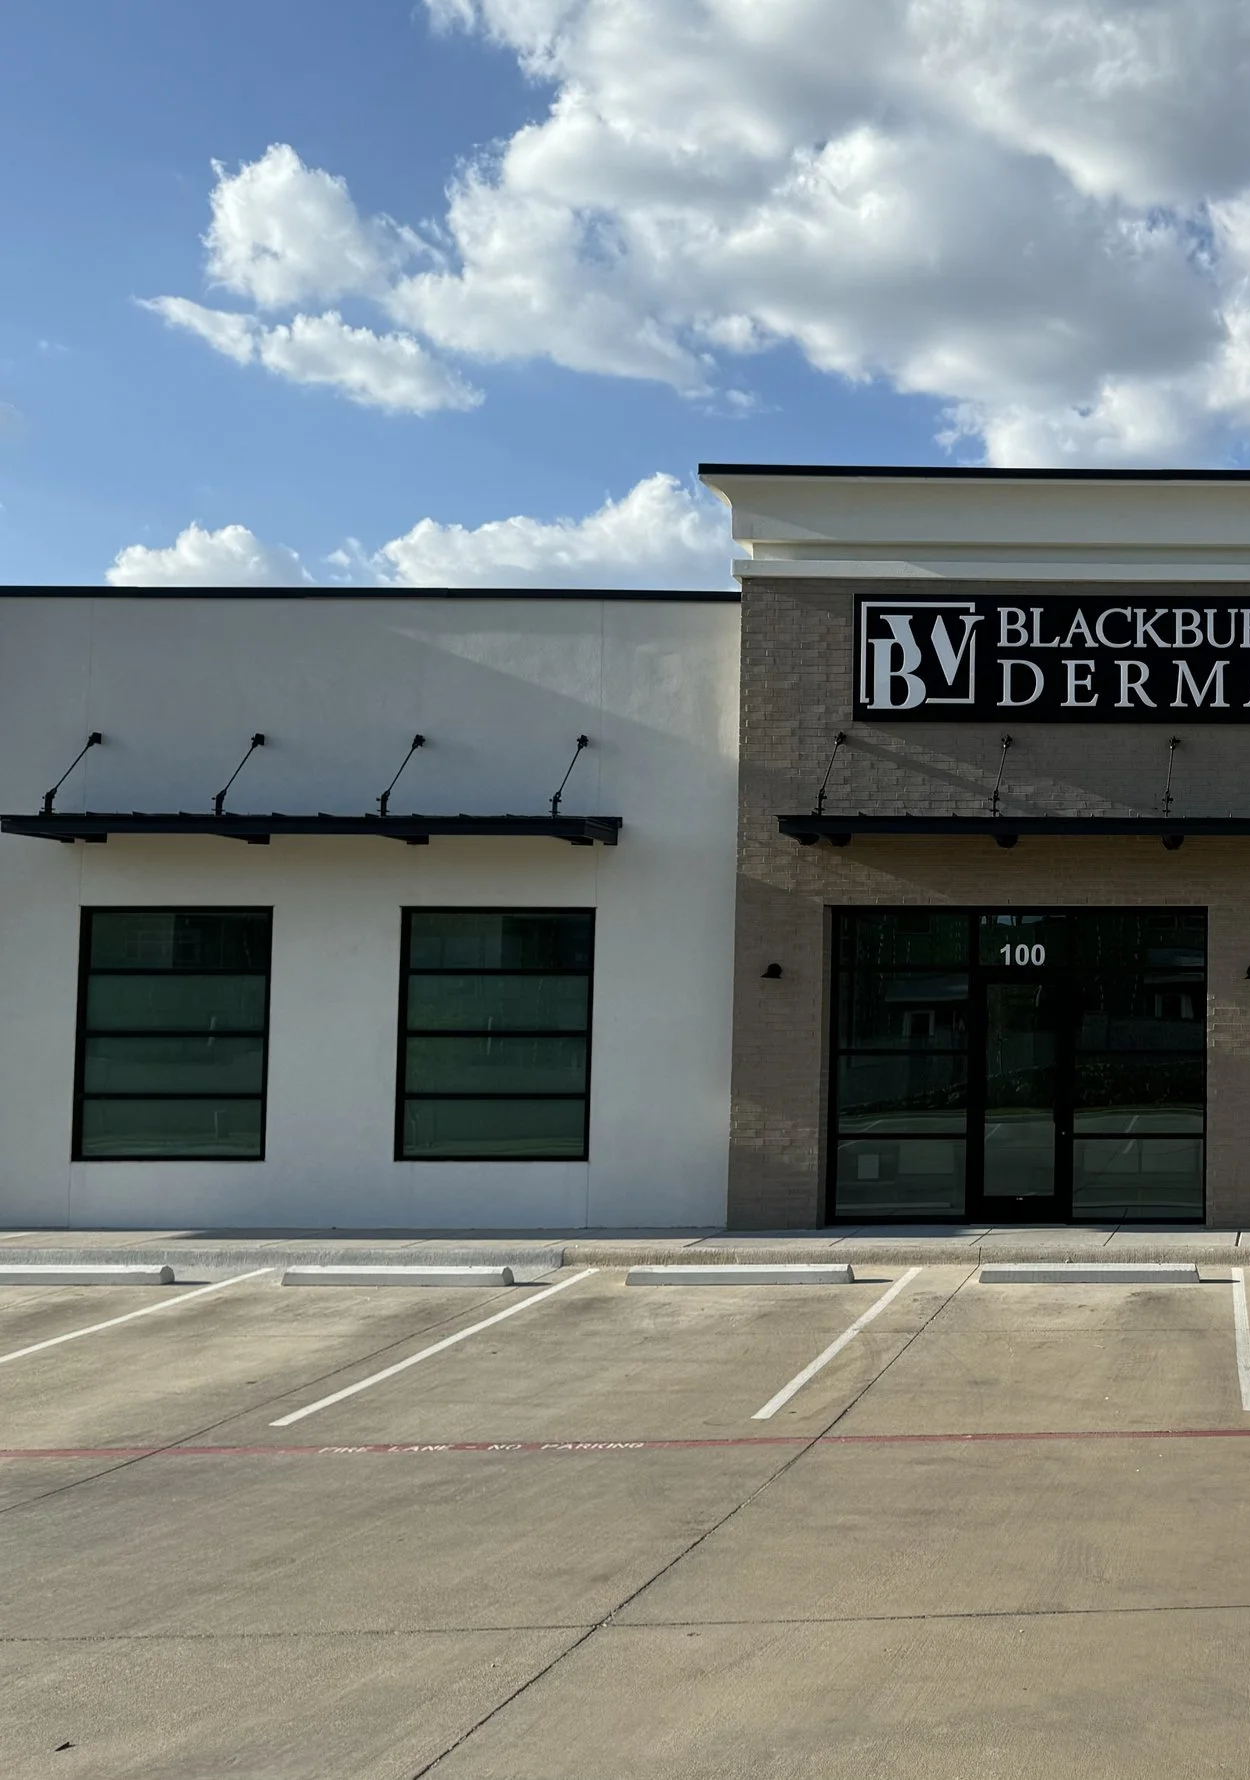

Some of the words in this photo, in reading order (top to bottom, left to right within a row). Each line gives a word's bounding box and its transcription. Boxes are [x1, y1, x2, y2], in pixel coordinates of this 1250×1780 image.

[1000, 943, 1046, 966] 100
[317, 1445, 373, 1454] FIRE
[387, 1444, 455, 1453] LANE
[487, 1443, 522, 1451] NO
[540, 1441, 645, 1451] PARKING
